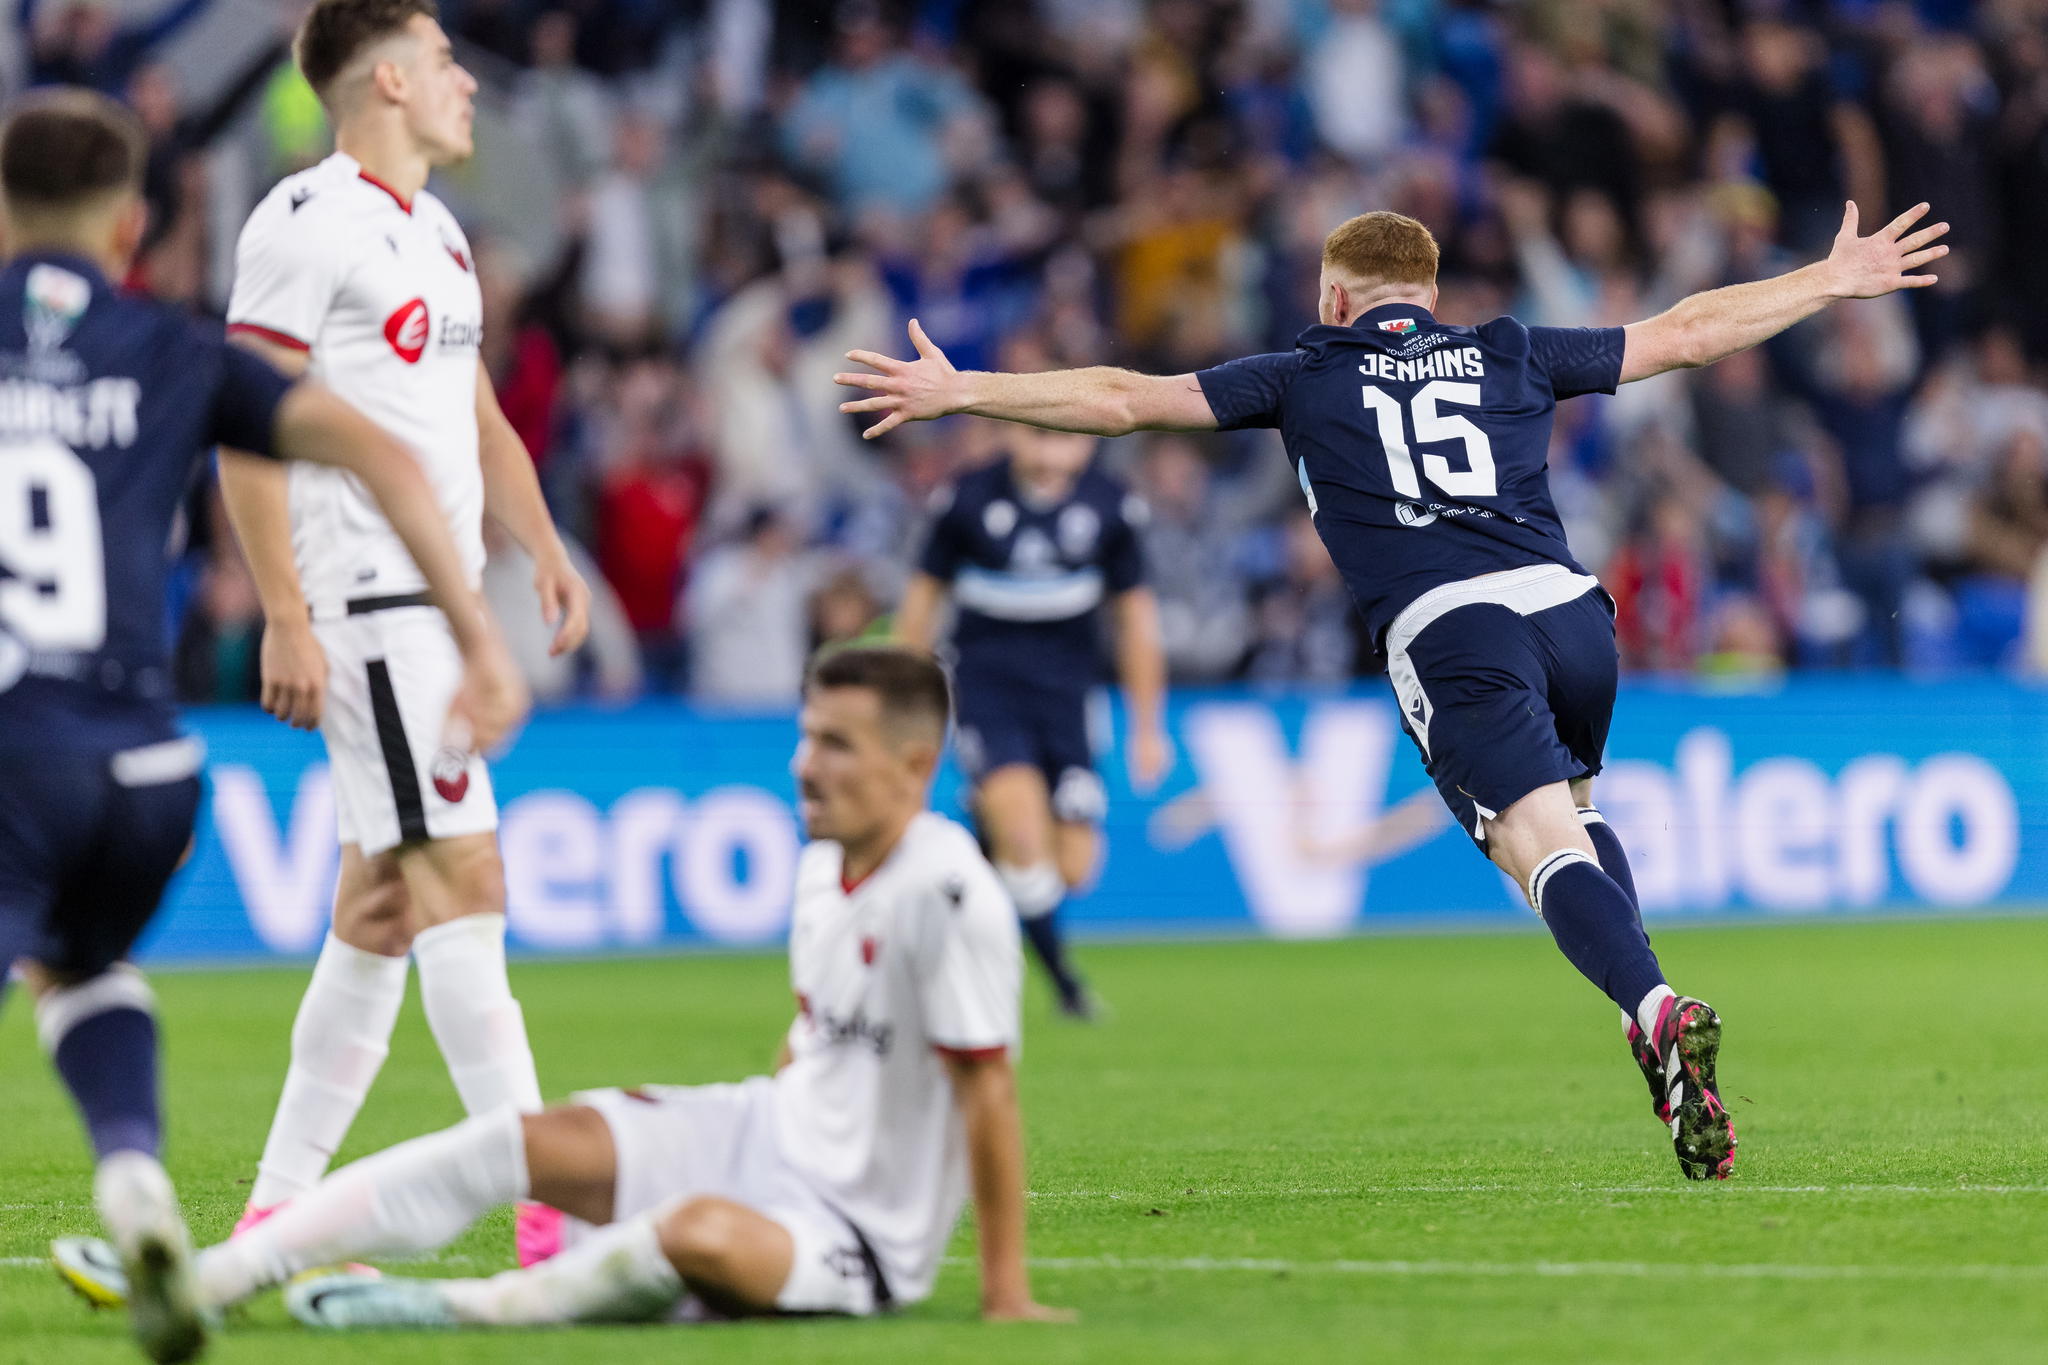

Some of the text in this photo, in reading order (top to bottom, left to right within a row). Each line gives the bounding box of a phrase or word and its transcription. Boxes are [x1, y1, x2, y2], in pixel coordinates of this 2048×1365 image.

[1358, 347, 1484, 381] JENKINS
[1403, 334, 1422, 347] WORLD
[1416, 337, 1449, 352] WAITER
[1418, 333, 1440, 346] CHEF
[1362, 380, 1498, 498] 15
[0, 437, 105, 651] 9
[1502, 727, 2018, 908] alero
[212, 761, 800, 951] Vero
